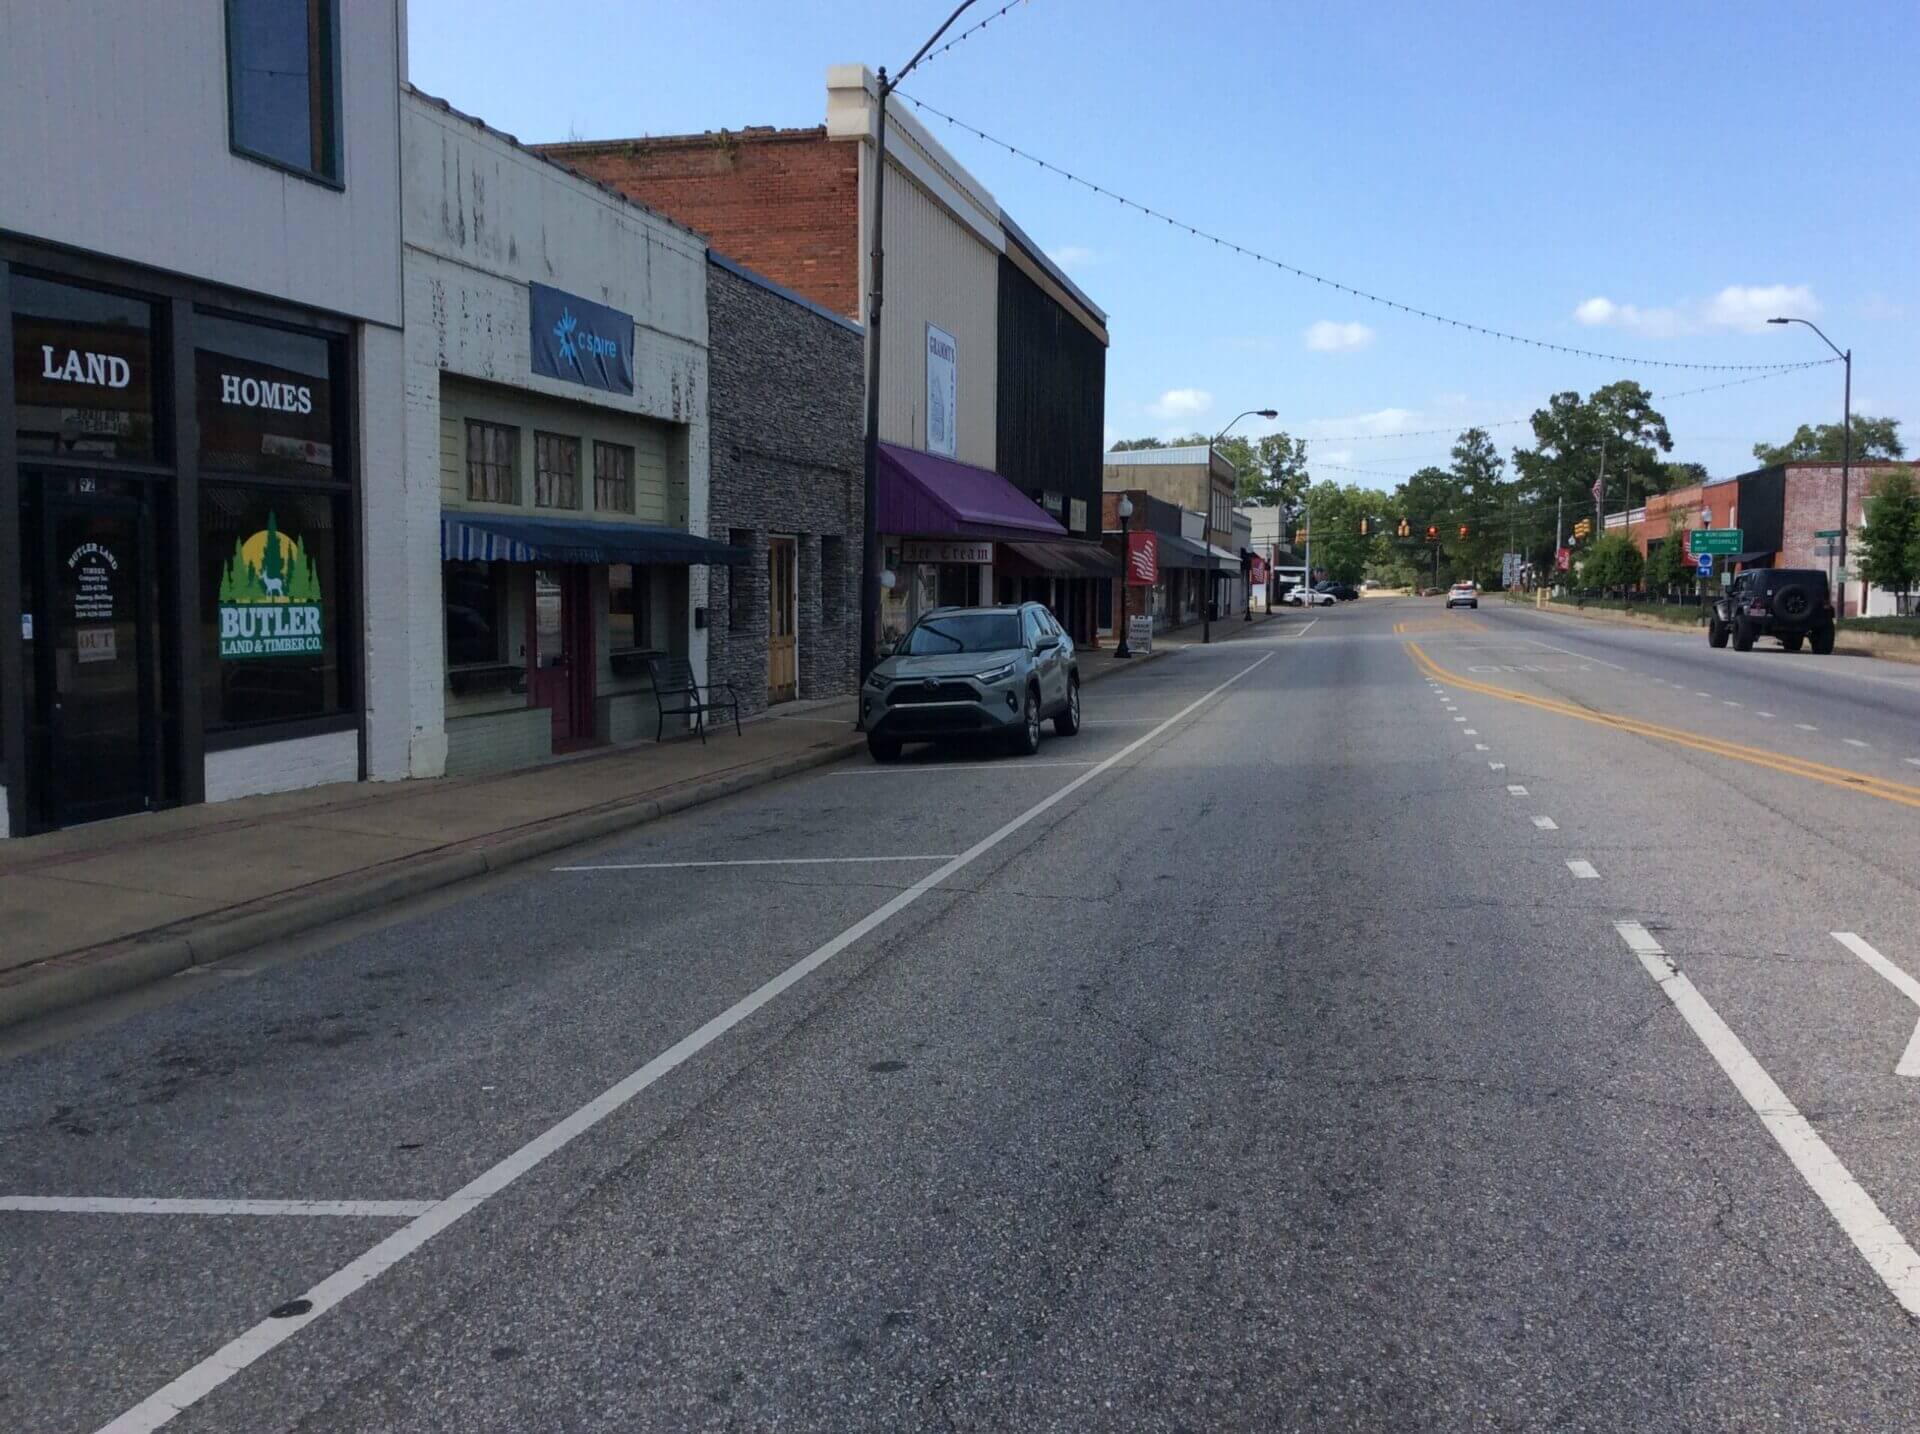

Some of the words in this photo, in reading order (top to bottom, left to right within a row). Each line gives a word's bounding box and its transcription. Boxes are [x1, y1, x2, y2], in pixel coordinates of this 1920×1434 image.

[41, 344, 130, 389] LAND
[221, 374, 312, 415] HOMES
[67, 542, 98, 569] BUTLER
[99, 545, 118, 570] LAND
[940, 544, 988, 560] Cream
[220, 606, 322, 638] BUTLER
[221, 640, 253, 655] LAND
[254, 639, 264, 653] &
[263, 637, 305, 652] TIMBER
[306, 637, 322, 650] CO.
